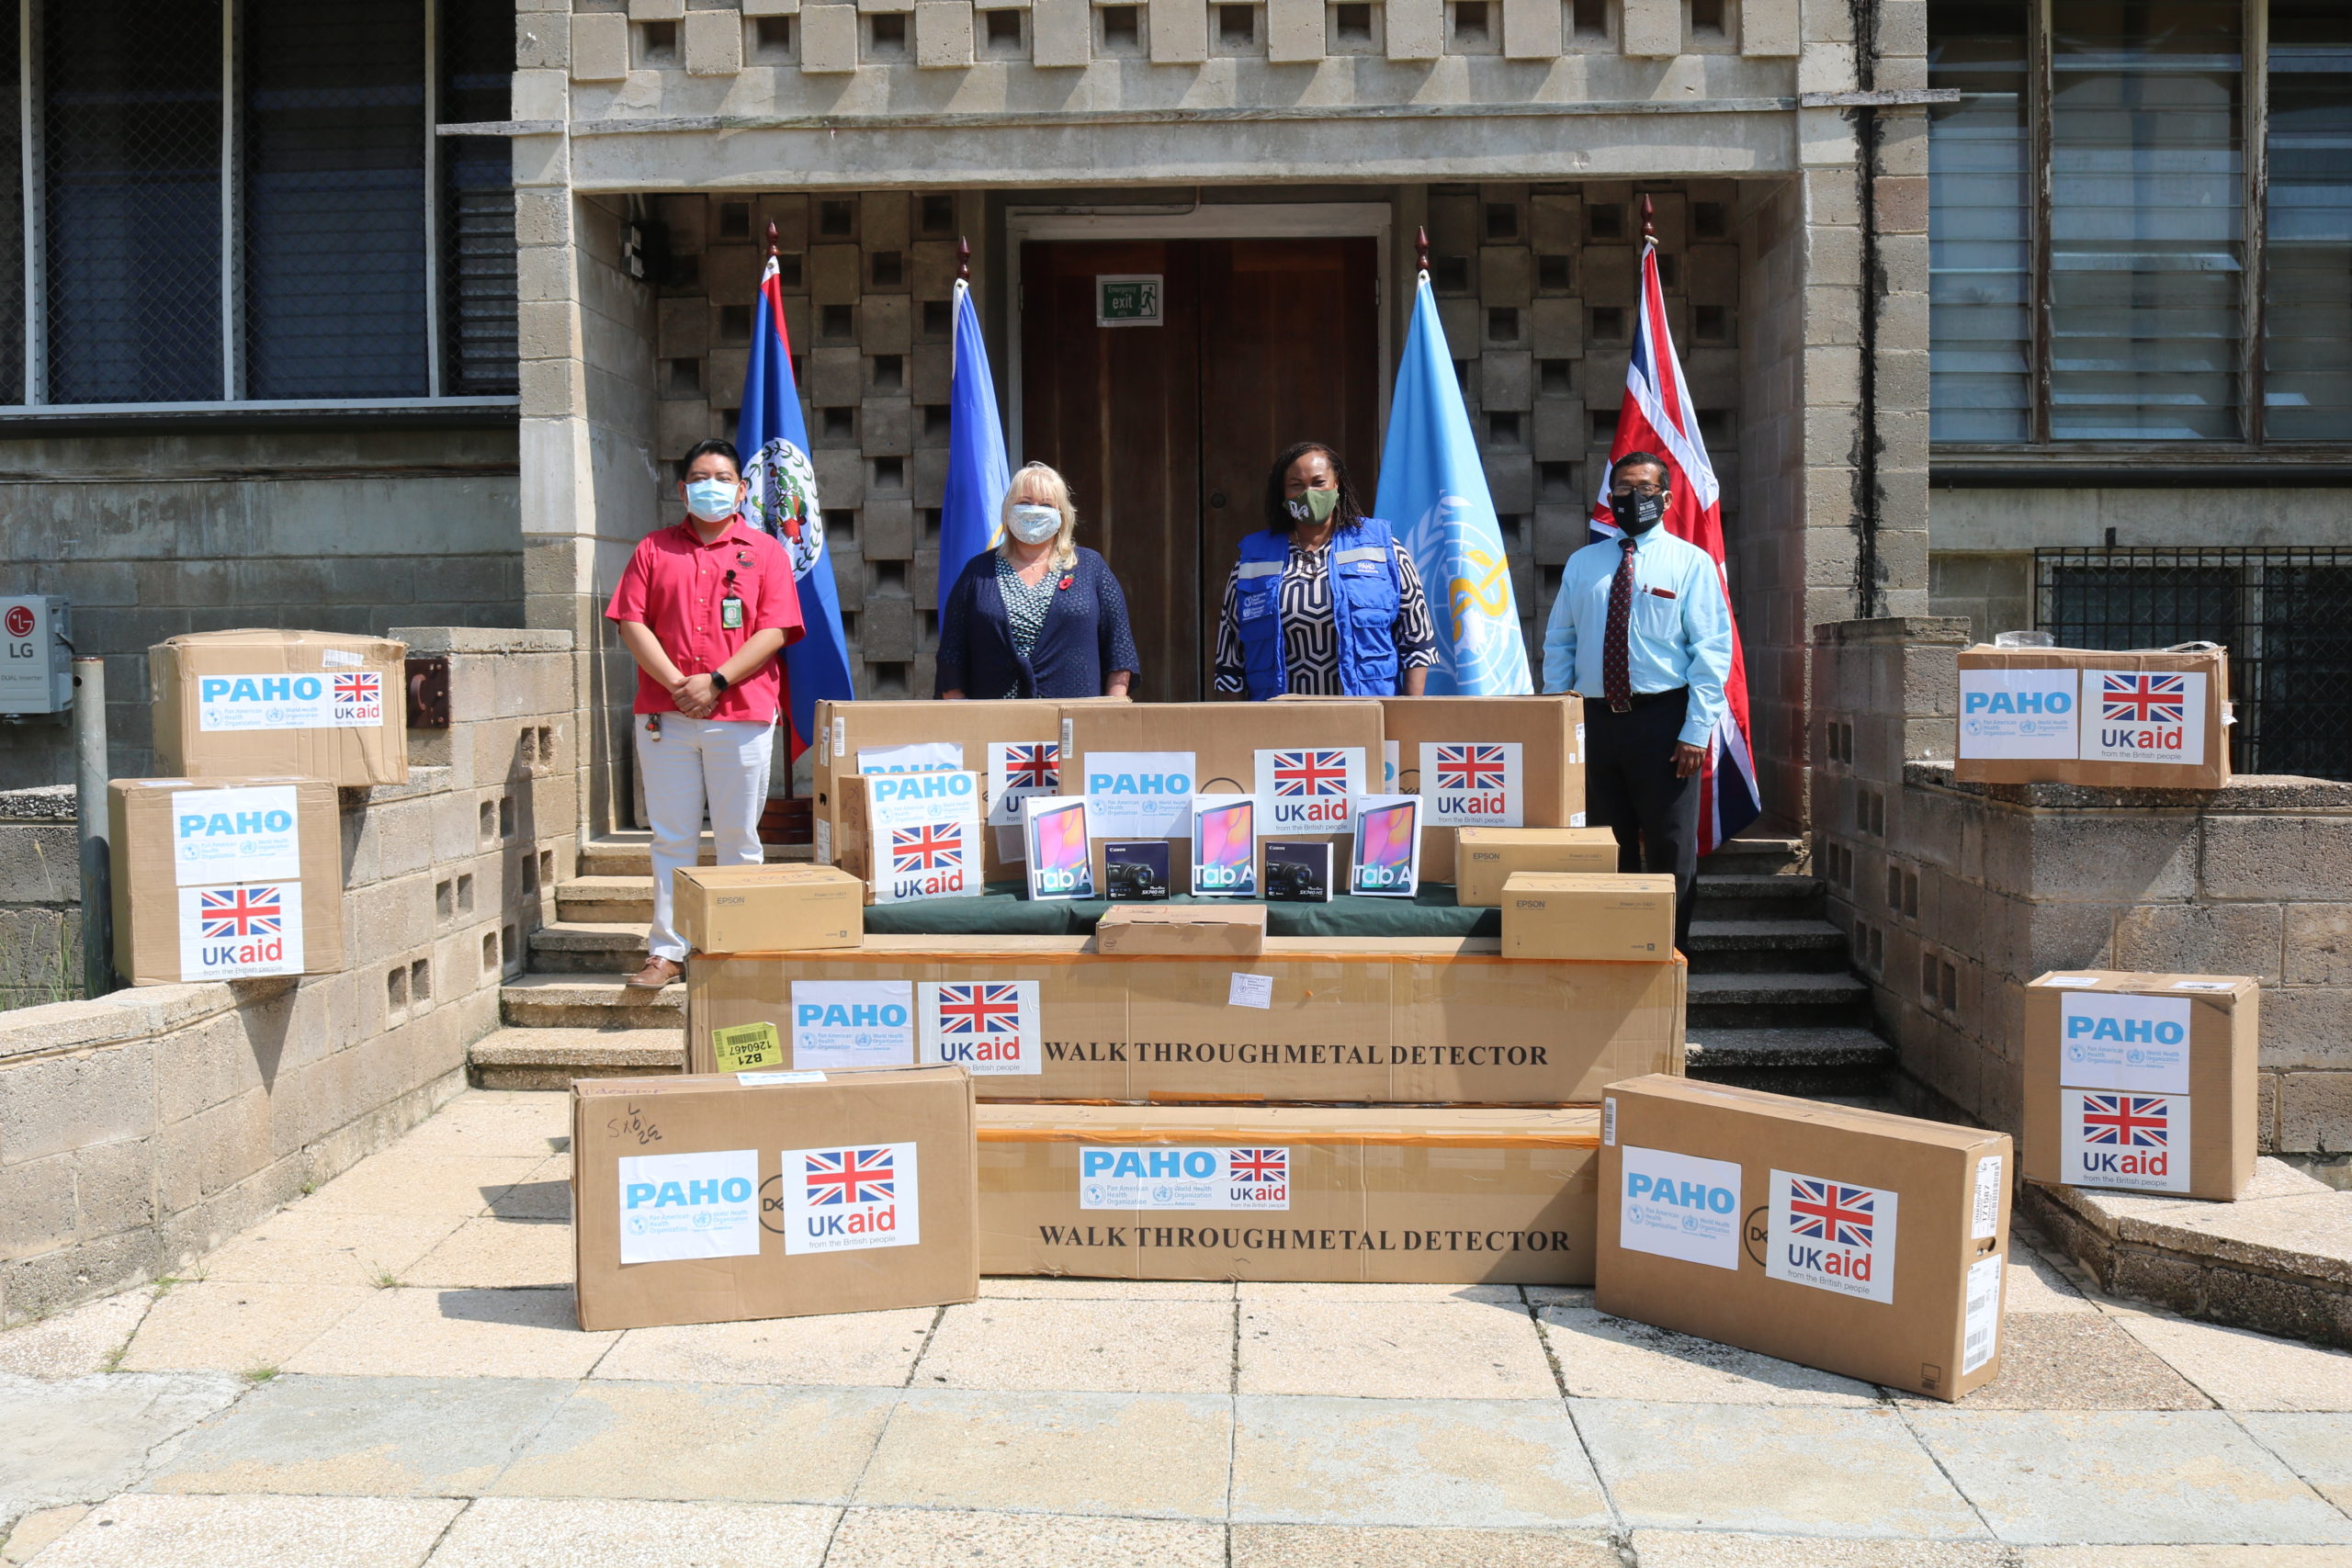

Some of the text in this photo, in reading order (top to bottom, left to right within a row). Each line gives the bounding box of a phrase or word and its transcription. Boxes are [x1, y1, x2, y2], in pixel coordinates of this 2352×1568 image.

[1108, 286, 1137, 294] Emergency
[1113, 293, 1133, 310] exit
[10, 643, 33, 659] LG
[202, 677, 322, 703] PAHO
[1965, 692, 2072, 714] PAHO
[875, 774, 972, 802] PAHO
[1091, 773, 1191, 795] PAHO
[180, 809, 292, 838] PAHO
[1034, 867, 1092, 889] Tab A
[1194, 864, 1257, 885] Tab A
[1354, 865, 1413, 885] Tab A
[717, 897, 745, 905] EPSON
[798, 1004, 907, 1027] PAHO
[2067, 1016, 2184, 1045] PAHO
[729, 1041, 772, 1055] 1260467
[1044, 1042, 1128, 1062] WALK
[1390, 1045, 1549, 1066] DETECTOR
[739, 1053, 763, 1066] BZ1
[2087, 1057, 2122, 1066] Organization
[1084, 1151, 1216, 1179] PAHO
[1628, 1172, 1736, 1214] PAHO
[2142, 1179, 2166, 1187] people
[627, 1177, 752, 1210] PAHO
[1174, 1191, 1212, 1200] Organization
[1657, 1210, 1679, 1219] American
[1714, 1220, 1730, 1228] Health
[1645, 1220, 1678, 1231] Organization
[1700, 1224, 1730, 1235] Organization
[843, 1237, 867, 1246] British
[870, 1235, 896, 1245] people
[1038, 1225, 1127, 1247] WALK
[1292, 1229, 1396, 1250] METAL
[1403, 1230, 1570, 1252] DETECTOR
[1788, 1269, 1870, 1294] from the British people
